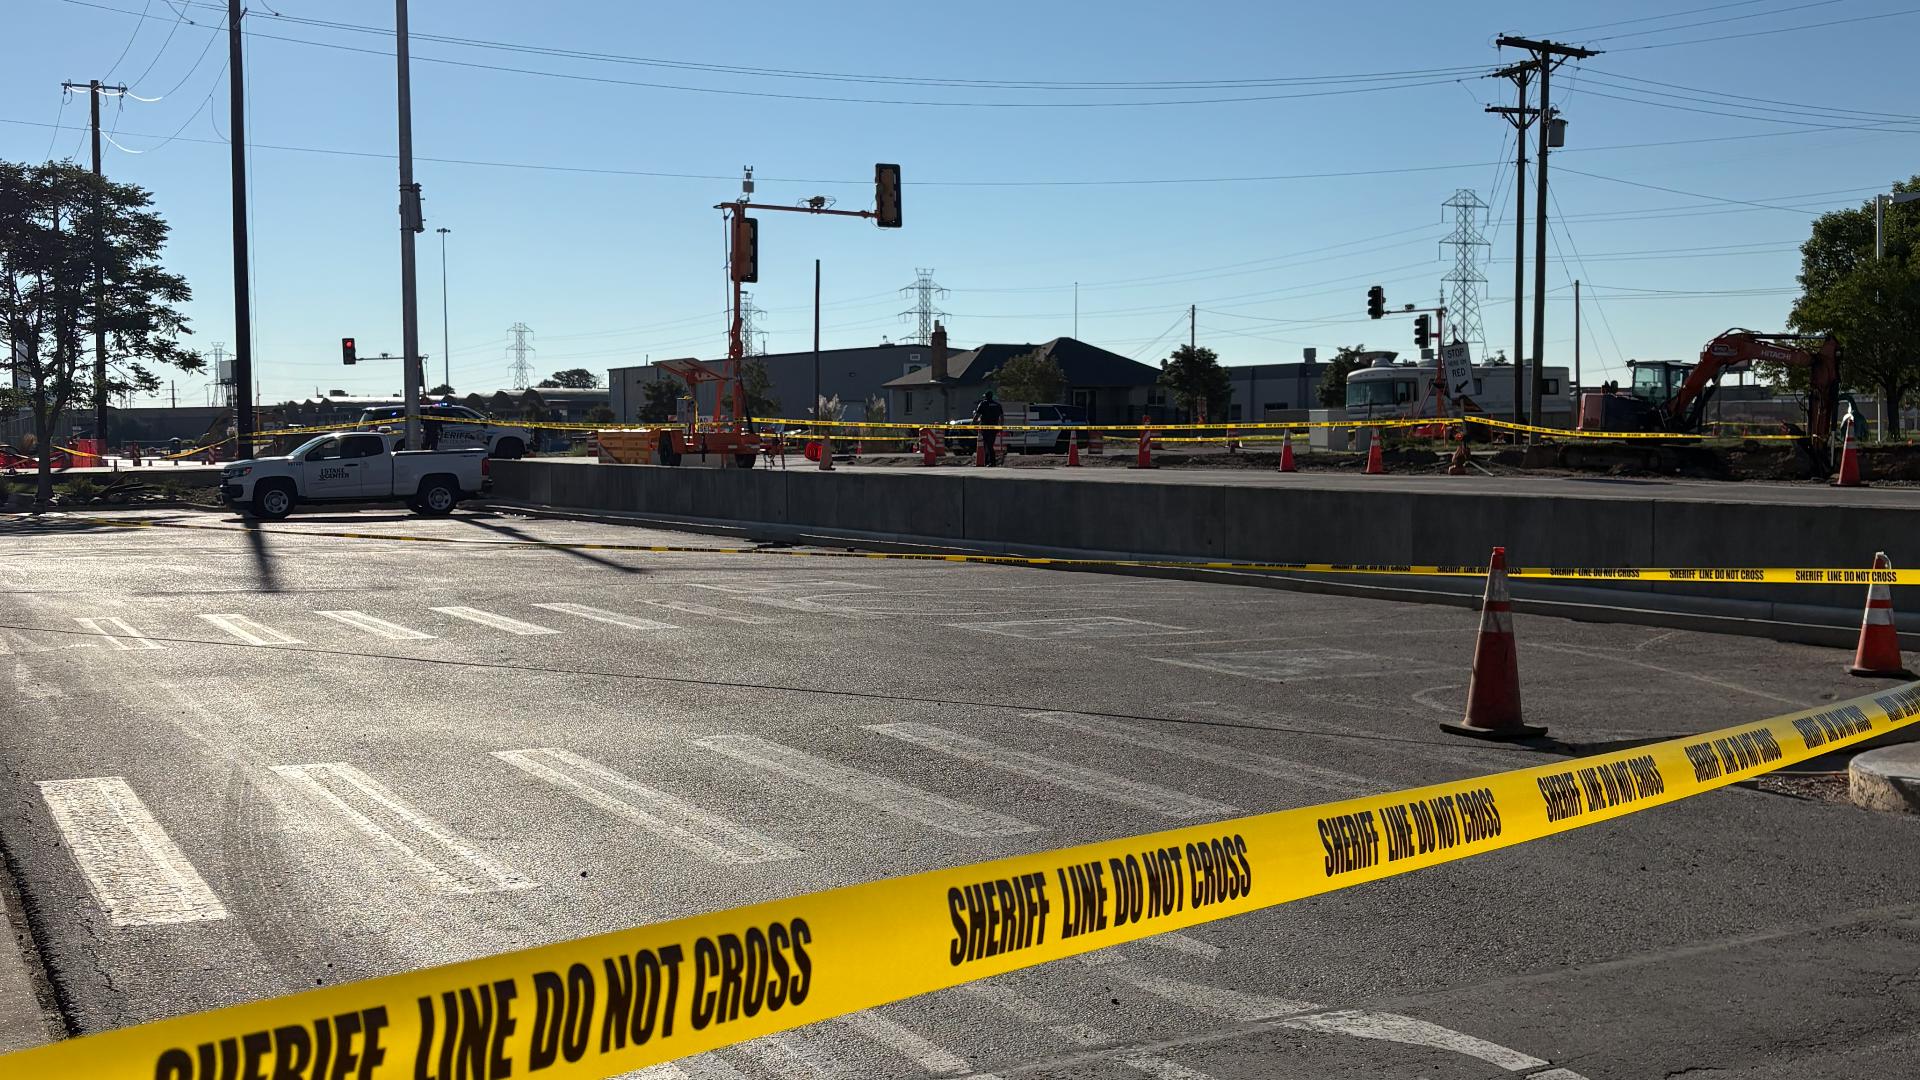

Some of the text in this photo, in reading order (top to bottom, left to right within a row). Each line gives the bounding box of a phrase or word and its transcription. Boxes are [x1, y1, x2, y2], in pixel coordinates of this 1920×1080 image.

[1447, 347, 1464, 358] STOP
[1452, 367, 1466, 377] RED
[1761, 349, 1792, 361] HITACHI
[1669, 569, 1764, 580] SHERIFF LINE DO NOT CROSS
[1795, 570, 1897, 583] SHERIFF LINE DO NOT CROSS
[1792, 705, 1873, 750] SHERIFF LINE DO NOT CROSS
[1684, 727, 1783, 783] SHERIFF LINE DO NOT CROSS
[1537, 754, 1665, 823] SHERIFF LINE DO NOT CROSS
[1317, 787, 1502, 878] SHERIFF LINE DO NOT CROSS
[947, 833, 1252, 967] SHERIFF LINE DO NOT CROSS
[414, 979, 518, 1080] LINE
[529, 962, 595, 1073] DO
[600, 943, 685, 1055] NOT
[691, 917, 813, 1032] CROSS
